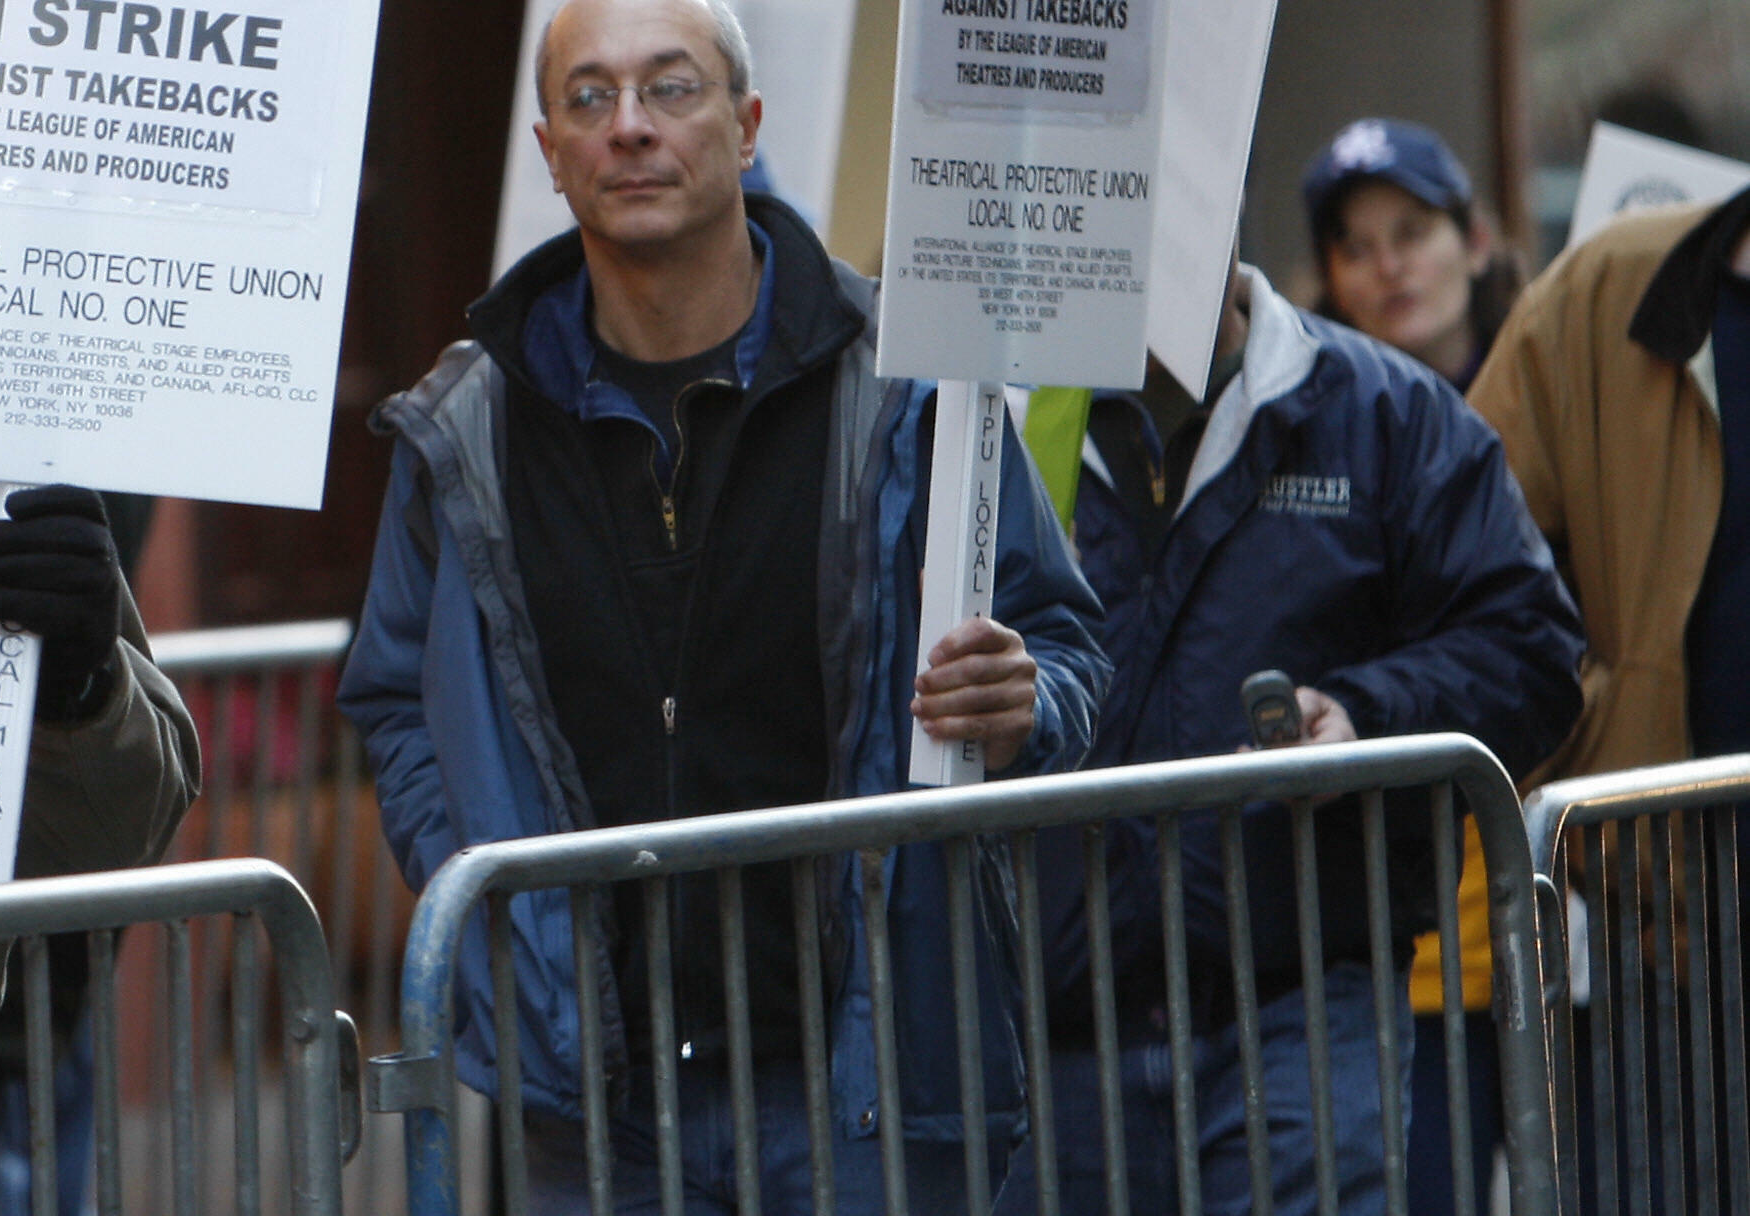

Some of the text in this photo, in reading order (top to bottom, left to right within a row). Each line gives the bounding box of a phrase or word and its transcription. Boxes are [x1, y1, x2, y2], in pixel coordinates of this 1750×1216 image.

[957, 27, 1107, 60] BY THE LEAGUE OF AMERICAN
[956, 61, 1104, 95] THEATRES AND PRODUCERS
[64, 69, 279, 123] TAKEBACKS
[5, 108, 88, 138] LEAGUE
[93, 117, 121, 141] OF
[125, 121, 234, 154] AMERICAN
[41, 148, 88, 174] AND
[94, 153, 229, 190] PRODUCERS
[910, 156, 1148, 200] THEATRICAL PROTECTIVE UNION
[967, 198, 1016, 229] LOCAL
[1051, 203, 1084, 233] ONE
[22, 247, 215, 291] PROTECTIVE
[229, 266, 323, 301] UNION
[123, 295, 188, 329] ONE
[29, 330, 51, 344] OF
[57, 332, 145, 354] THEATRICAL
[152, 341, 198, 359] STAGE
[113, 372, 146, 387] AND
[287, 387, 317, 402] CLC
[136, 357, 168, 372] AND
[174, 361, 225, 377] ALLIED
[230, 365, 291, 383] CRAFTS
[65, 400, 88, 414] NY
[88, 385, 147, 402] STREET
[3, 411, 102, 432] 212-333-2500
[972, 394, 997, 593] TPU LOCAL
[1264, 475, 1350, 503] USTLER
